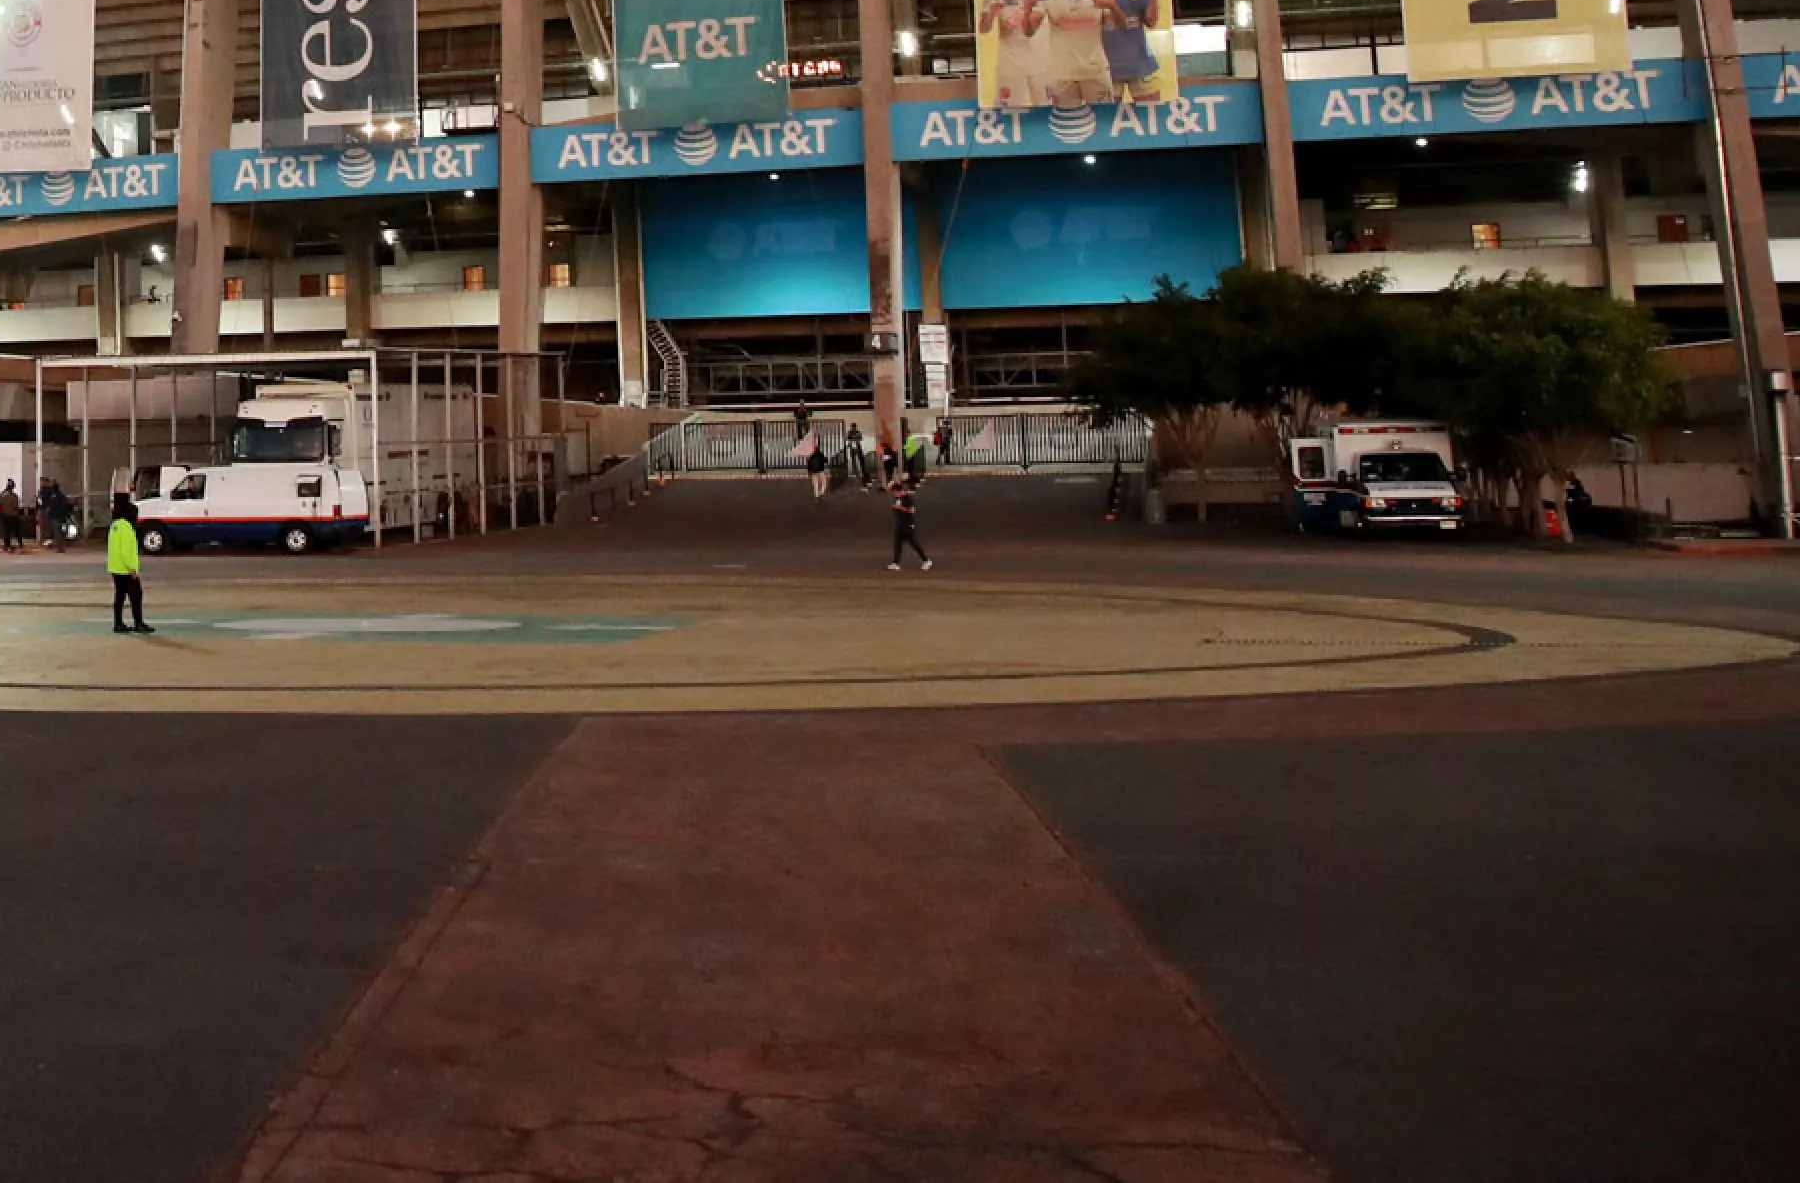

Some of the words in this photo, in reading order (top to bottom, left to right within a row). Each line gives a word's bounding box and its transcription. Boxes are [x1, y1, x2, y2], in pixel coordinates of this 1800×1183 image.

[638, 16, 759, 64] AT&T
[919, 107, 1030, 147] AT&T
[1109, 95, 1230, 138] AT&T
[1320, 85, 1443, 127] AT&T
[1530, 70, 1663, 116] AT&T
[233, 154, 325, 191] AT&T
[386, 143, 485, 183] AT&T
[556, 130, 660, 171] AT&T
[728, 119, 838, 161] AT&T
[83, 163, 169, 200] AT&T
